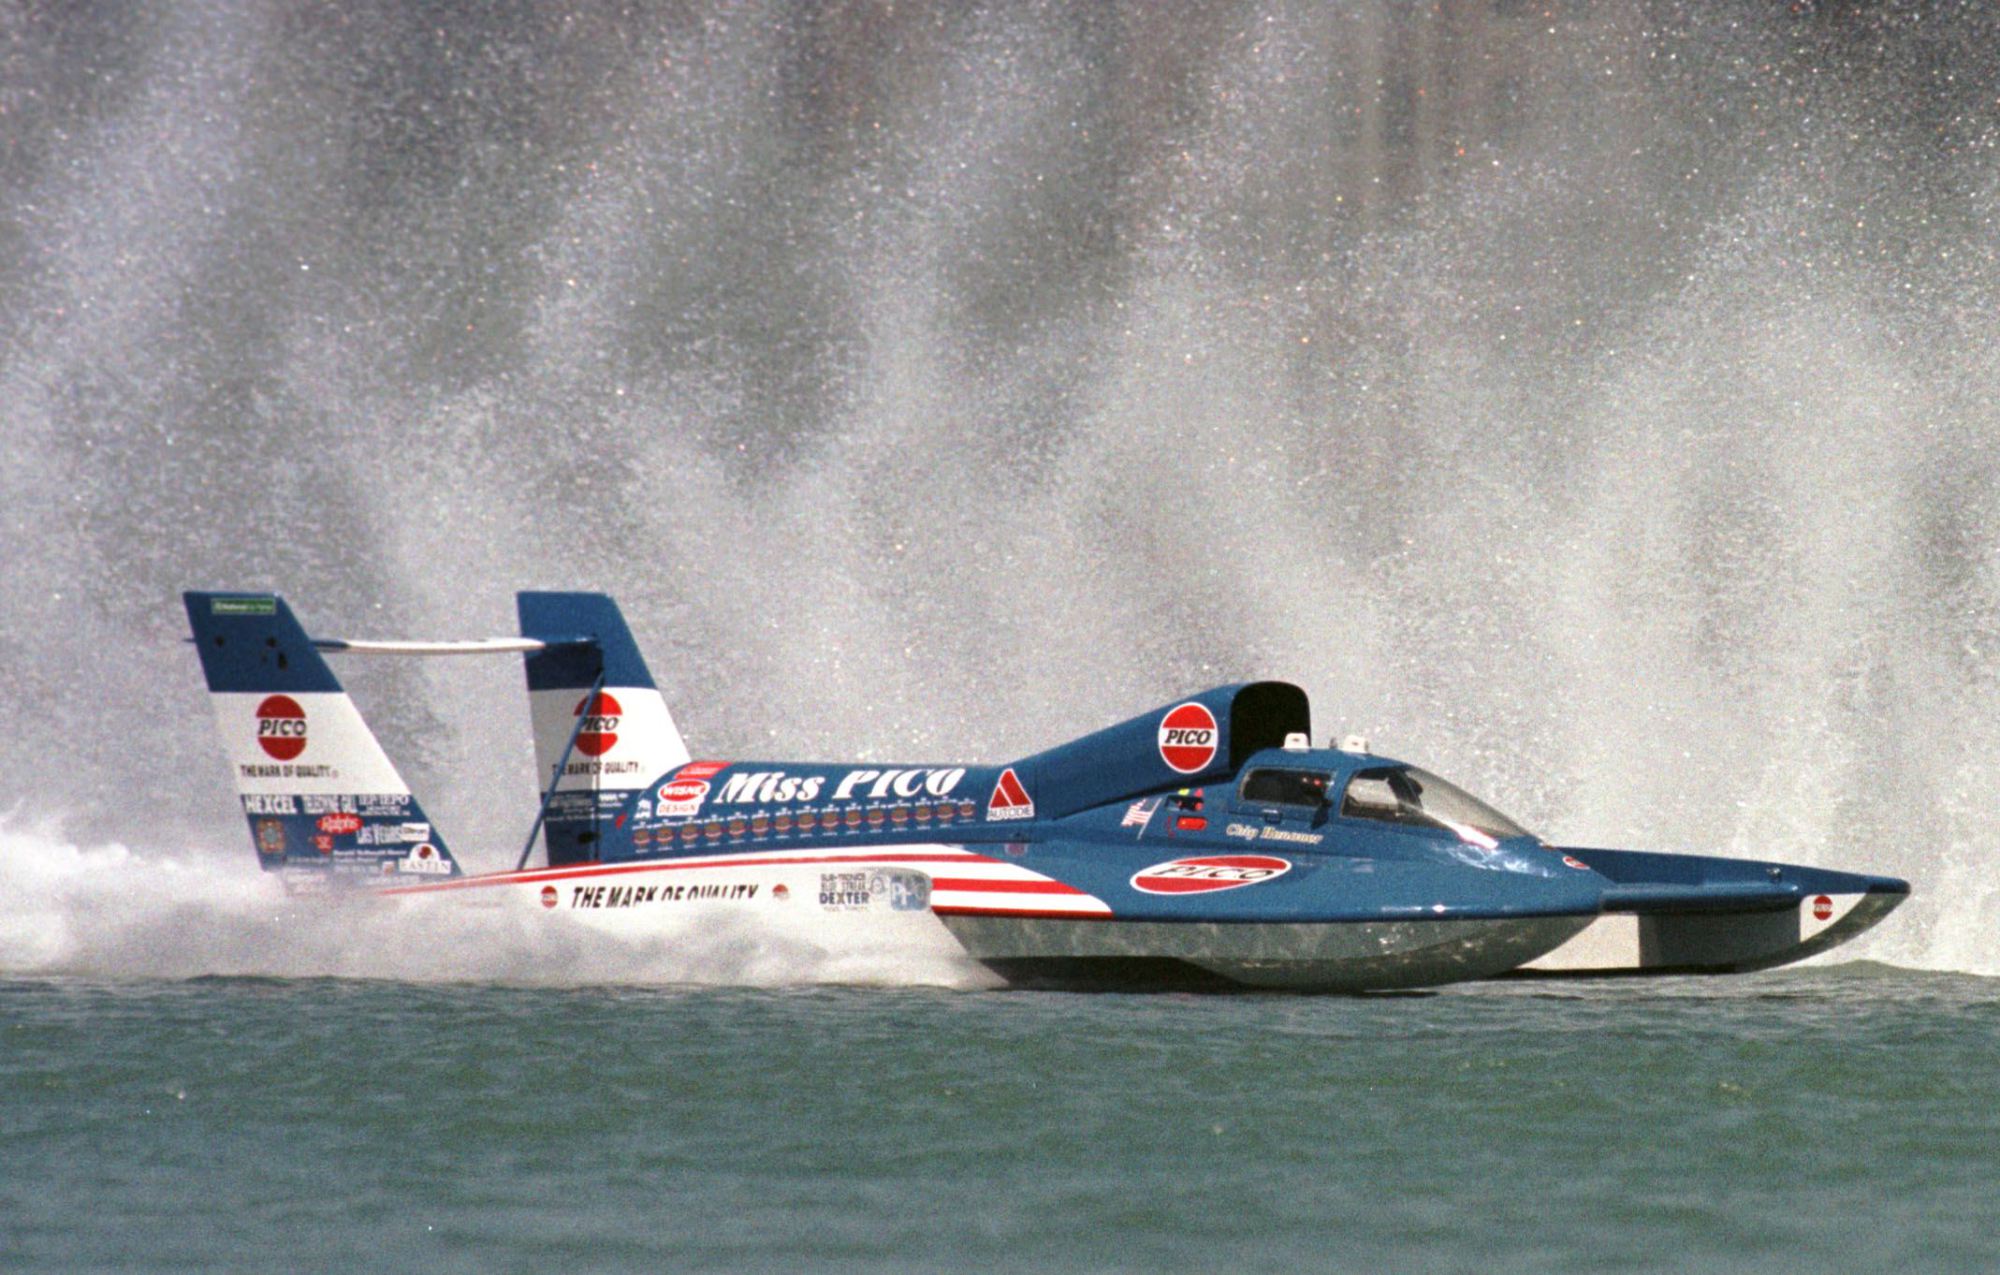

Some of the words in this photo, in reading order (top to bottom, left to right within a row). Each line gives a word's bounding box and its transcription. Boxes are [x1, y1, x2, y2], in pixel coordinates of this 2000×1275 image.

[259, 719, 307, 736] PICO
[1165, 729, 1211, 745] PICO
[713, 771, 826, 804] Miss
[832, 768, 966, 800] PICO
[659, 803, 696, 814] DESIGN
[1152, 866, 1274, 879] PICO
[572, 886, 605, 908] THE
[606, 886, 657, 908] MARK
[819, 892, 870, 905] DEXTER
